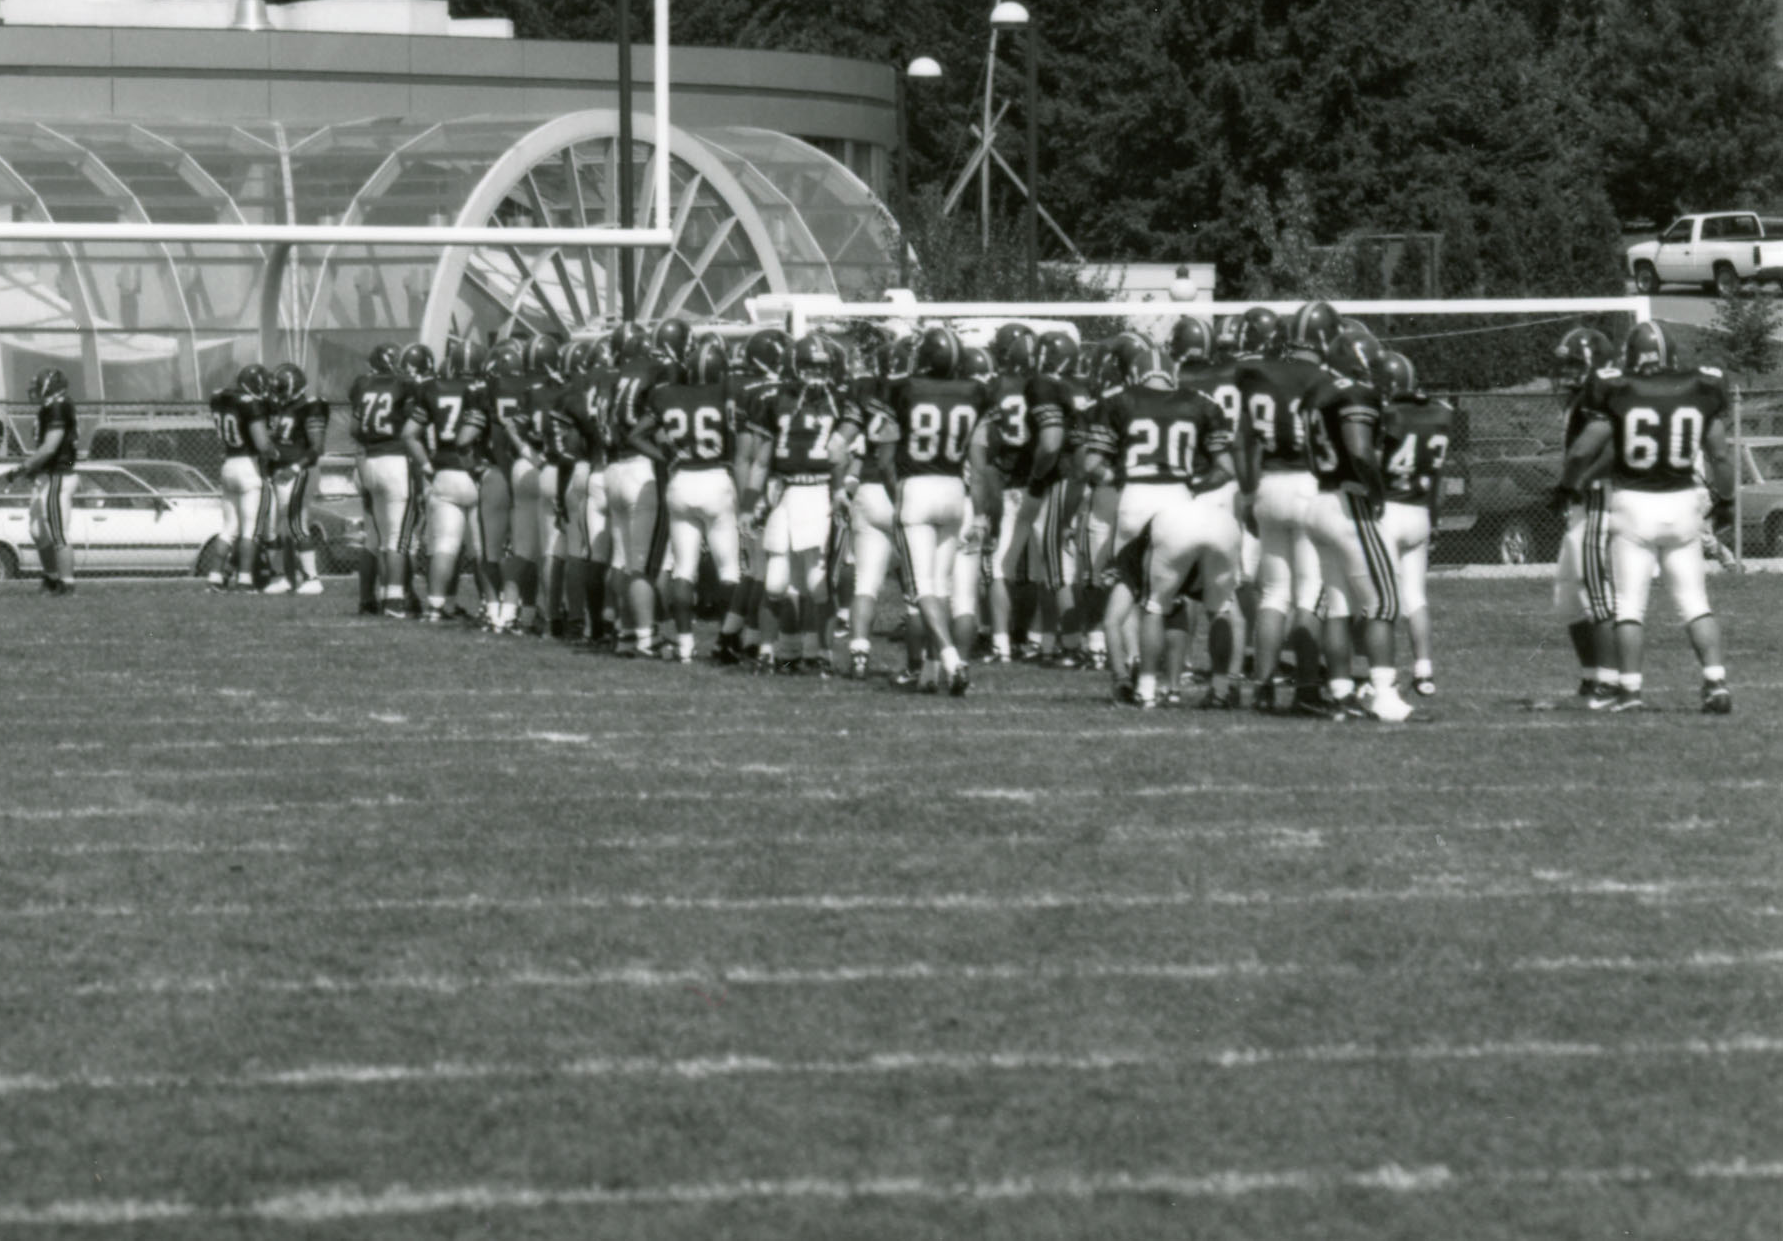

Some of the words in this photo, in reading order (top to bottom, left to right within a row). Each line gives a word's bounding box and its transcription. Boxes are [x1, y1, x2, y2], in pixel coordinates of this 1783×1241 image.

[361, 392, 393, 435] 72
[437, 396, 463, 440] 7
[662, 406, 723, 459] 26
[775, 413, 835, 459] 17
[908, 403, 977, 462] 80
[1625, 407, 1704, 469] 60
[1125, 418, 1198, 477] 20
